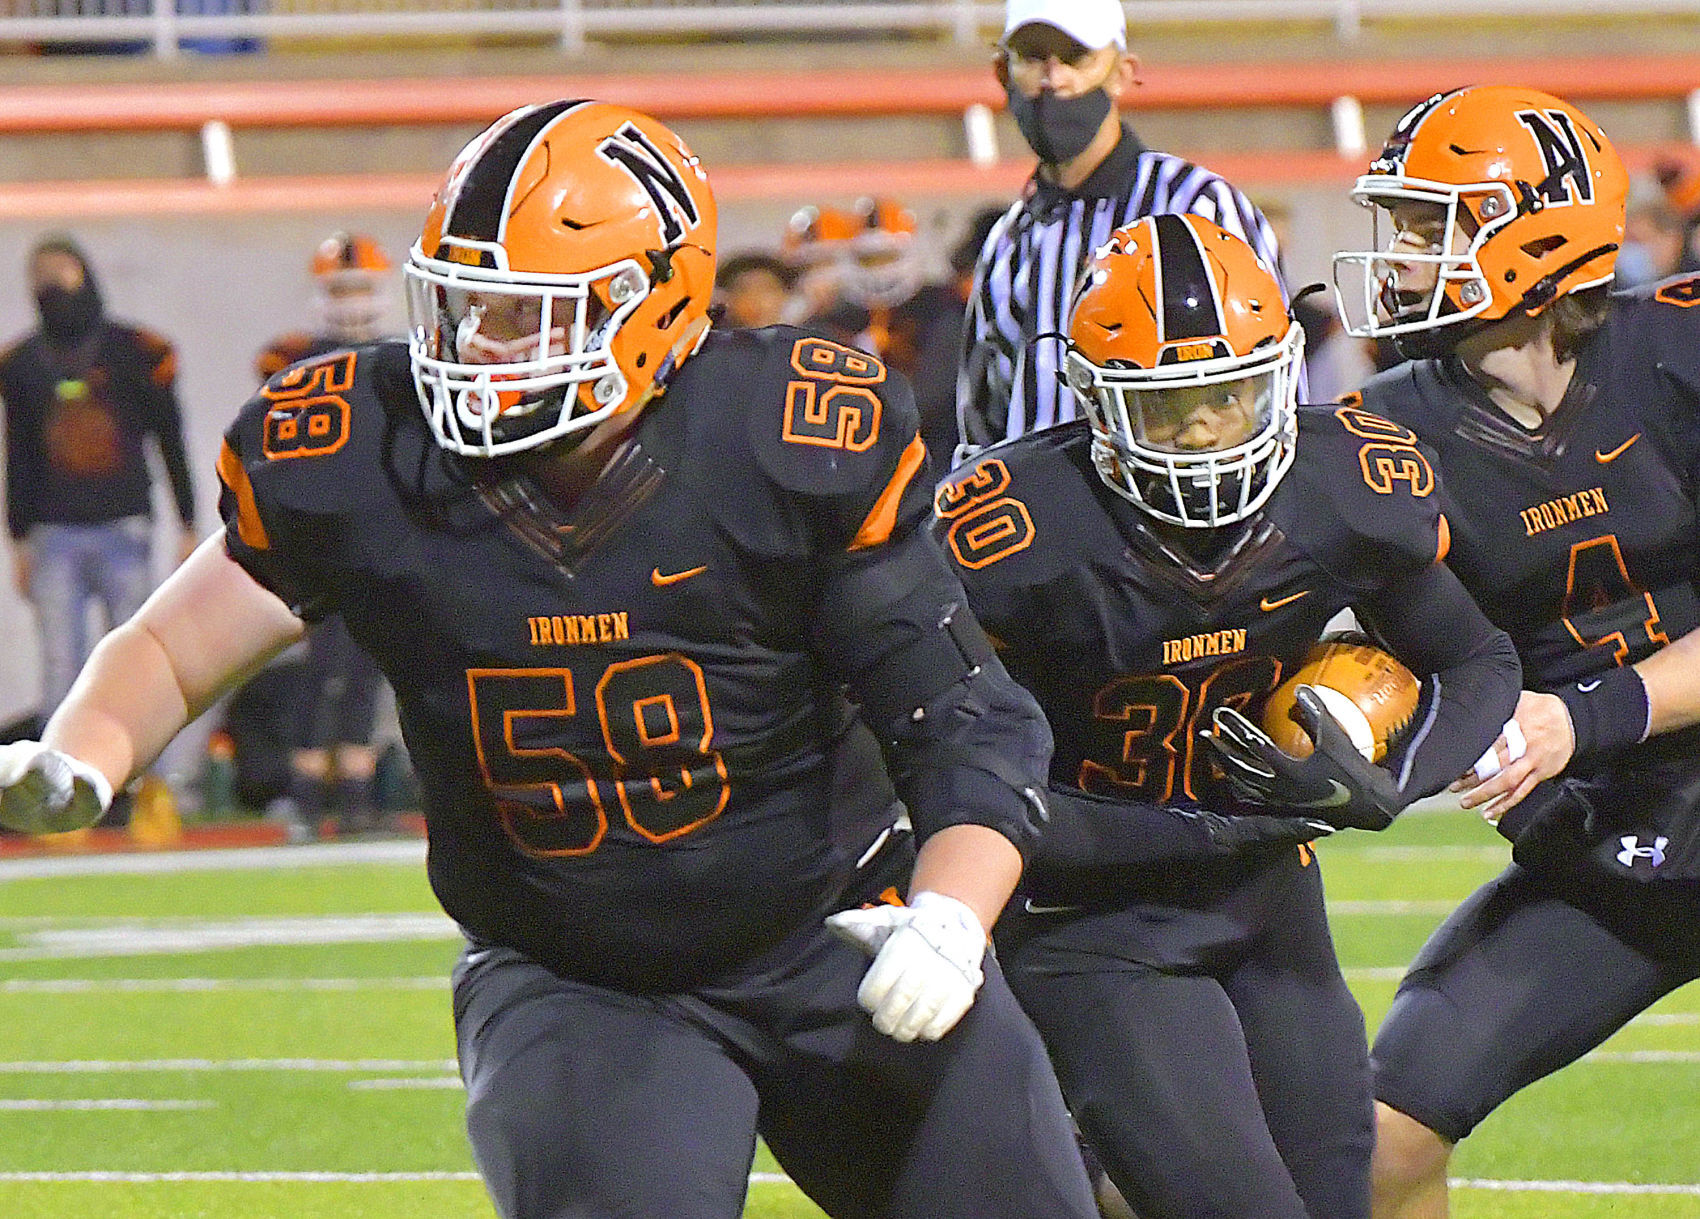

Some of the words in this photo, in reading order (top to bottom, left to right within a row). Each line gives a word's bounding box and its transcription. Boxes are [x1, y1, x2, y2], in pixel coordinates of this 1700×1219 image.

[594, 120, 701, 251] N
[1514, 109, 1595, 208] N
[260, 351, 357, 461] 58
[782, 337, 887, 452] 58
[1334, 407, 1435, 497] 30
[934, 459, 1036, 570] 30
[1520, 487, 1610, 537] IRONMEN
[528, 611, 629, 645] IRONMEN
[1162, 628, 1247, 665] IRONMEN
[1560, 534, 1671, 668] 4
[466, 652, 732, 858] 58
